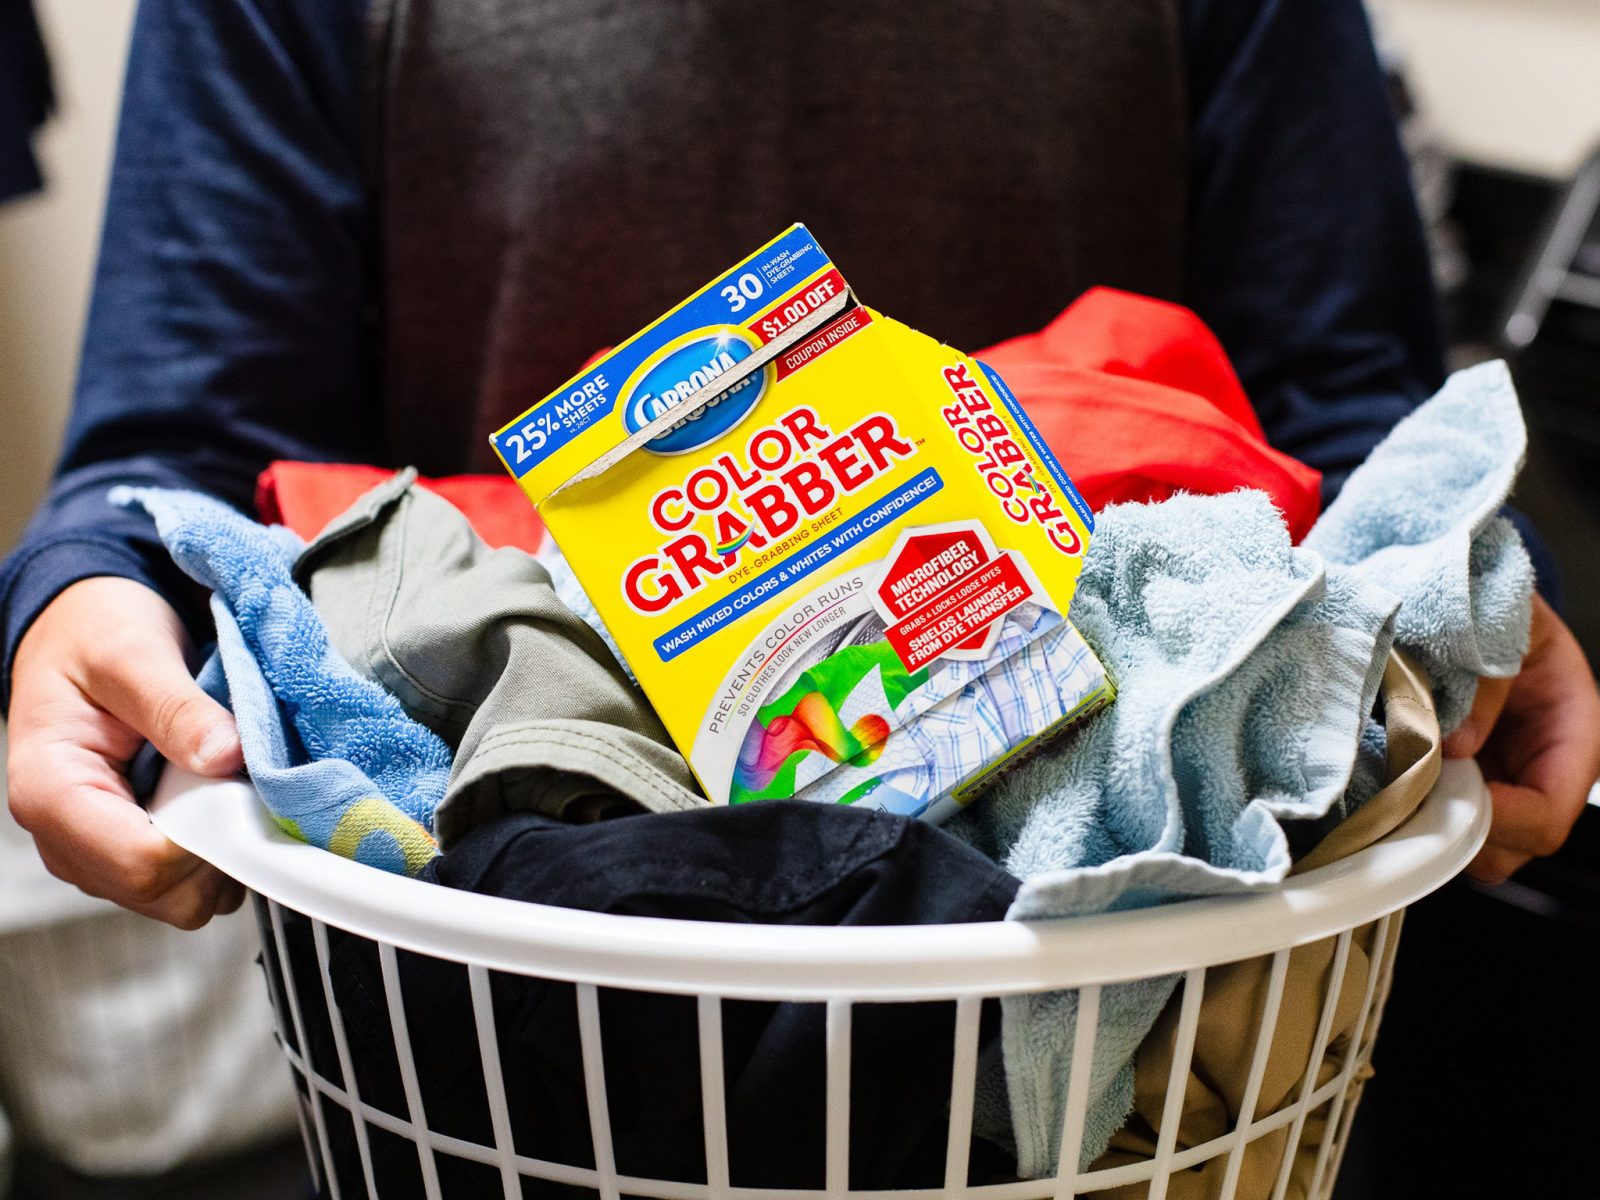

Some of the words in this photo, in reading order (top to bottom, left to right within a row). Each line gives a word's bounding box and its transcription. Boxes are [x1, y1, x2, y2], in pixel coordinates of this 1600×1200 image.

[762, 250, 790, 272] IN-WASH
[766, 243, 813, 278] DYE-GRABBING
[770, 265, 795, 284] SHEETS
[721, 273, 763, 312] 30
[762, 300, 808, 338] $1.00
[805, 279, 835, 308] OFF
[786, 338, 828, 369] COUPON
[826, 316, 860, 343] INSIDE
[555, 374, 609, 419] MORE
[562, 393, 607, 428] SHEETS
[505, 412, 560, 464] 25%
[943, 404, 1029, 522] COLOR
[944, 364, 1081, 555] GRABBER
[1029, 431, 1046, 455] WHITES
[652, 407, 829, 532] COLOR
[1048, 460, 1066, 485] COLORS
[1065, 485, 1080, 505] MIXED
[625, 415, 912, 612] GRABBER
[662, 628, 697, 653] WASH
[697, 606, 733, 632] MIXED
[734, 577, 779, 610] COLORS
[779, 571, 789, 582] &
[787, 544, 832, 575] WHITES
[831, 524, 863, 548] WITH
[863, 475, 937, 528] CONFIDENCE!
[728, 530, 810, 584] DYE-GRABBING
[811, 507, 843, 532] SHEET
[890, 540, 970, 598] MICROFIBER
[895, 550, 980, 612] TECHNOLOGY
[900, 614, 926, 636] GRABS
[931, 595, 957, 615] LOCKS
[956, 579, 981, 599] LOOSE
[980, 566, 1001, 583] DYES
[908, 638, 942, 666] FROM
[941, 624, 966, 644] DYE
[964, 585, 1025, 628] TRANSFER
[909, 615, 956, 651] SHIELDS
[956, 581, 1008, 620] LAUNDRY
[709, 650, 765, 734] PREVENTS
[765, 604, 816, 649] COLOR
[817, 577, 863, 608] RUNS
[738, 704, 750, 717] SO
[745, 664, 776, 704] CLOTHES
[774, 645, 796, 667] LOOK
[794, 630, 812, 650] NEW
[812, 606, 846, 633] LONGER
